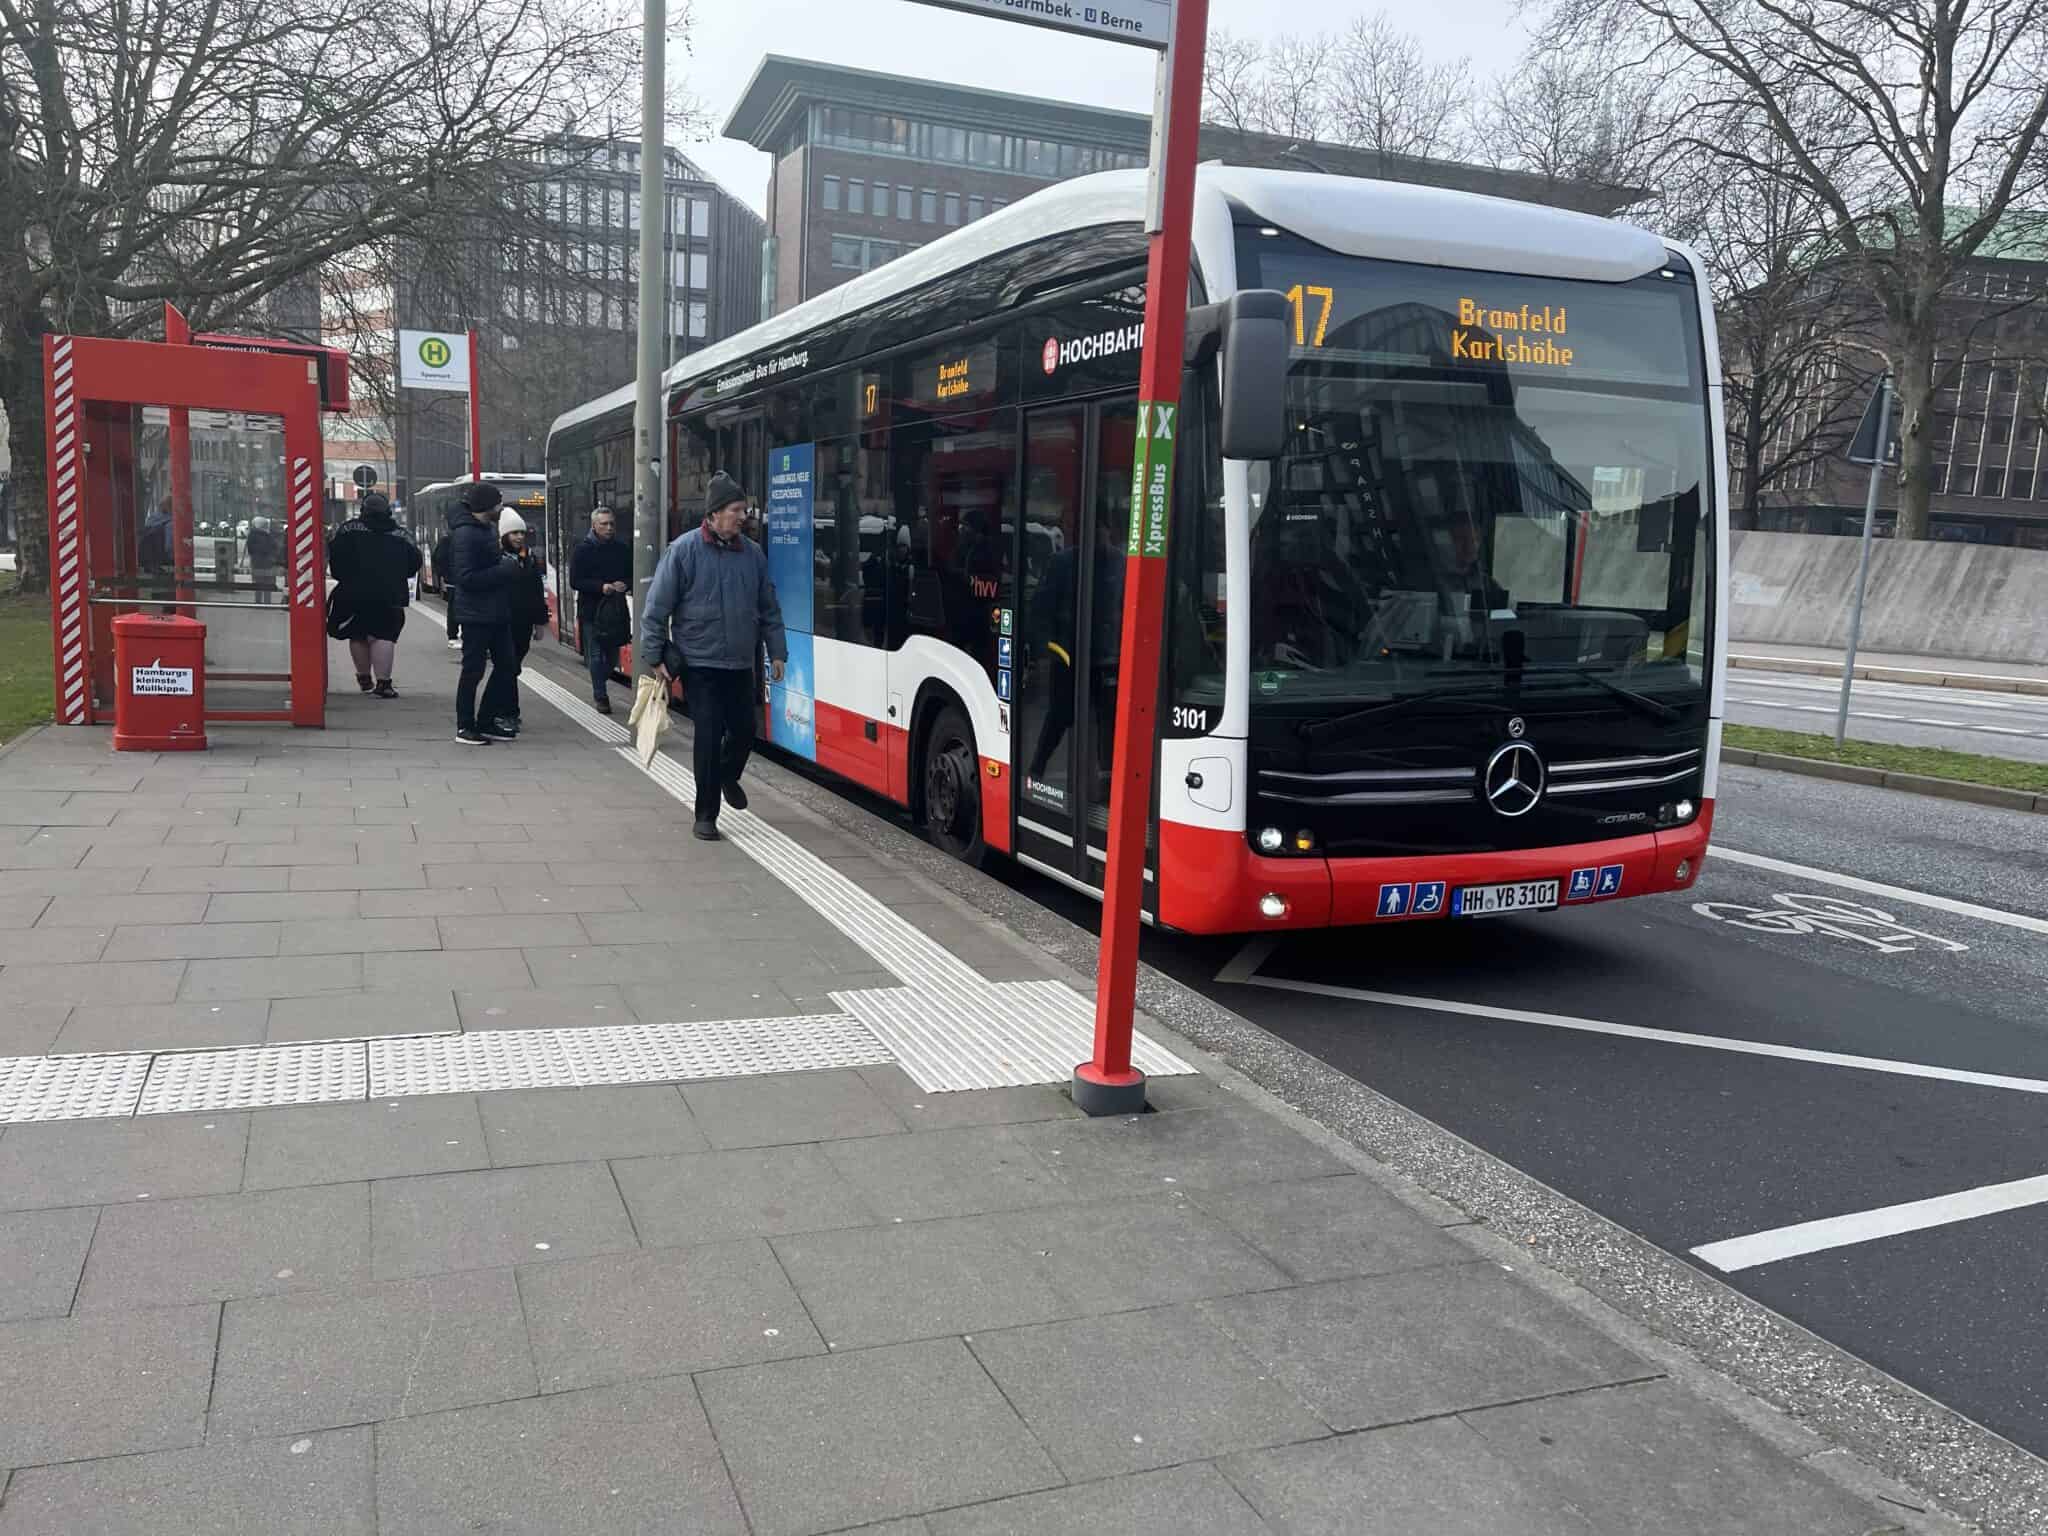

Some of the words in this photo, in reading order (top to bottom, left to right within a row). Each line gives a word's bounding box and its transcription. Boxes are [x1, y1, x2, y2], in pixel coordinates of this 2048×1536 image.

[1101, 11, 1143, 32] Berne
[1287, 284, 1333, 347] 17
[1459, 297, 1567, 334] Bramfeld
[1452, 329, 1573, 366] Karlshöhe
[756, 364, 768, 379] Bus
[769, 359, 778, 376] für
[866, 384, 876, 413] 17
[1137, 406, 1149, 438] X
[1154, 406, 1174, 440] X
[1128, 463, 1144, 551] XpressBus
[1145, 463, 1167, 553] XpressBus
[974, 576, 997, 597] hvv
[136, 669, 187, 678] Hamburgs
[1173, 706, 1206, 730] 3101
[1463, 889, 1484, 911] HH
[1496, 886, 1516, 906] YB
[1518, 884, 1556, 905] 3101
